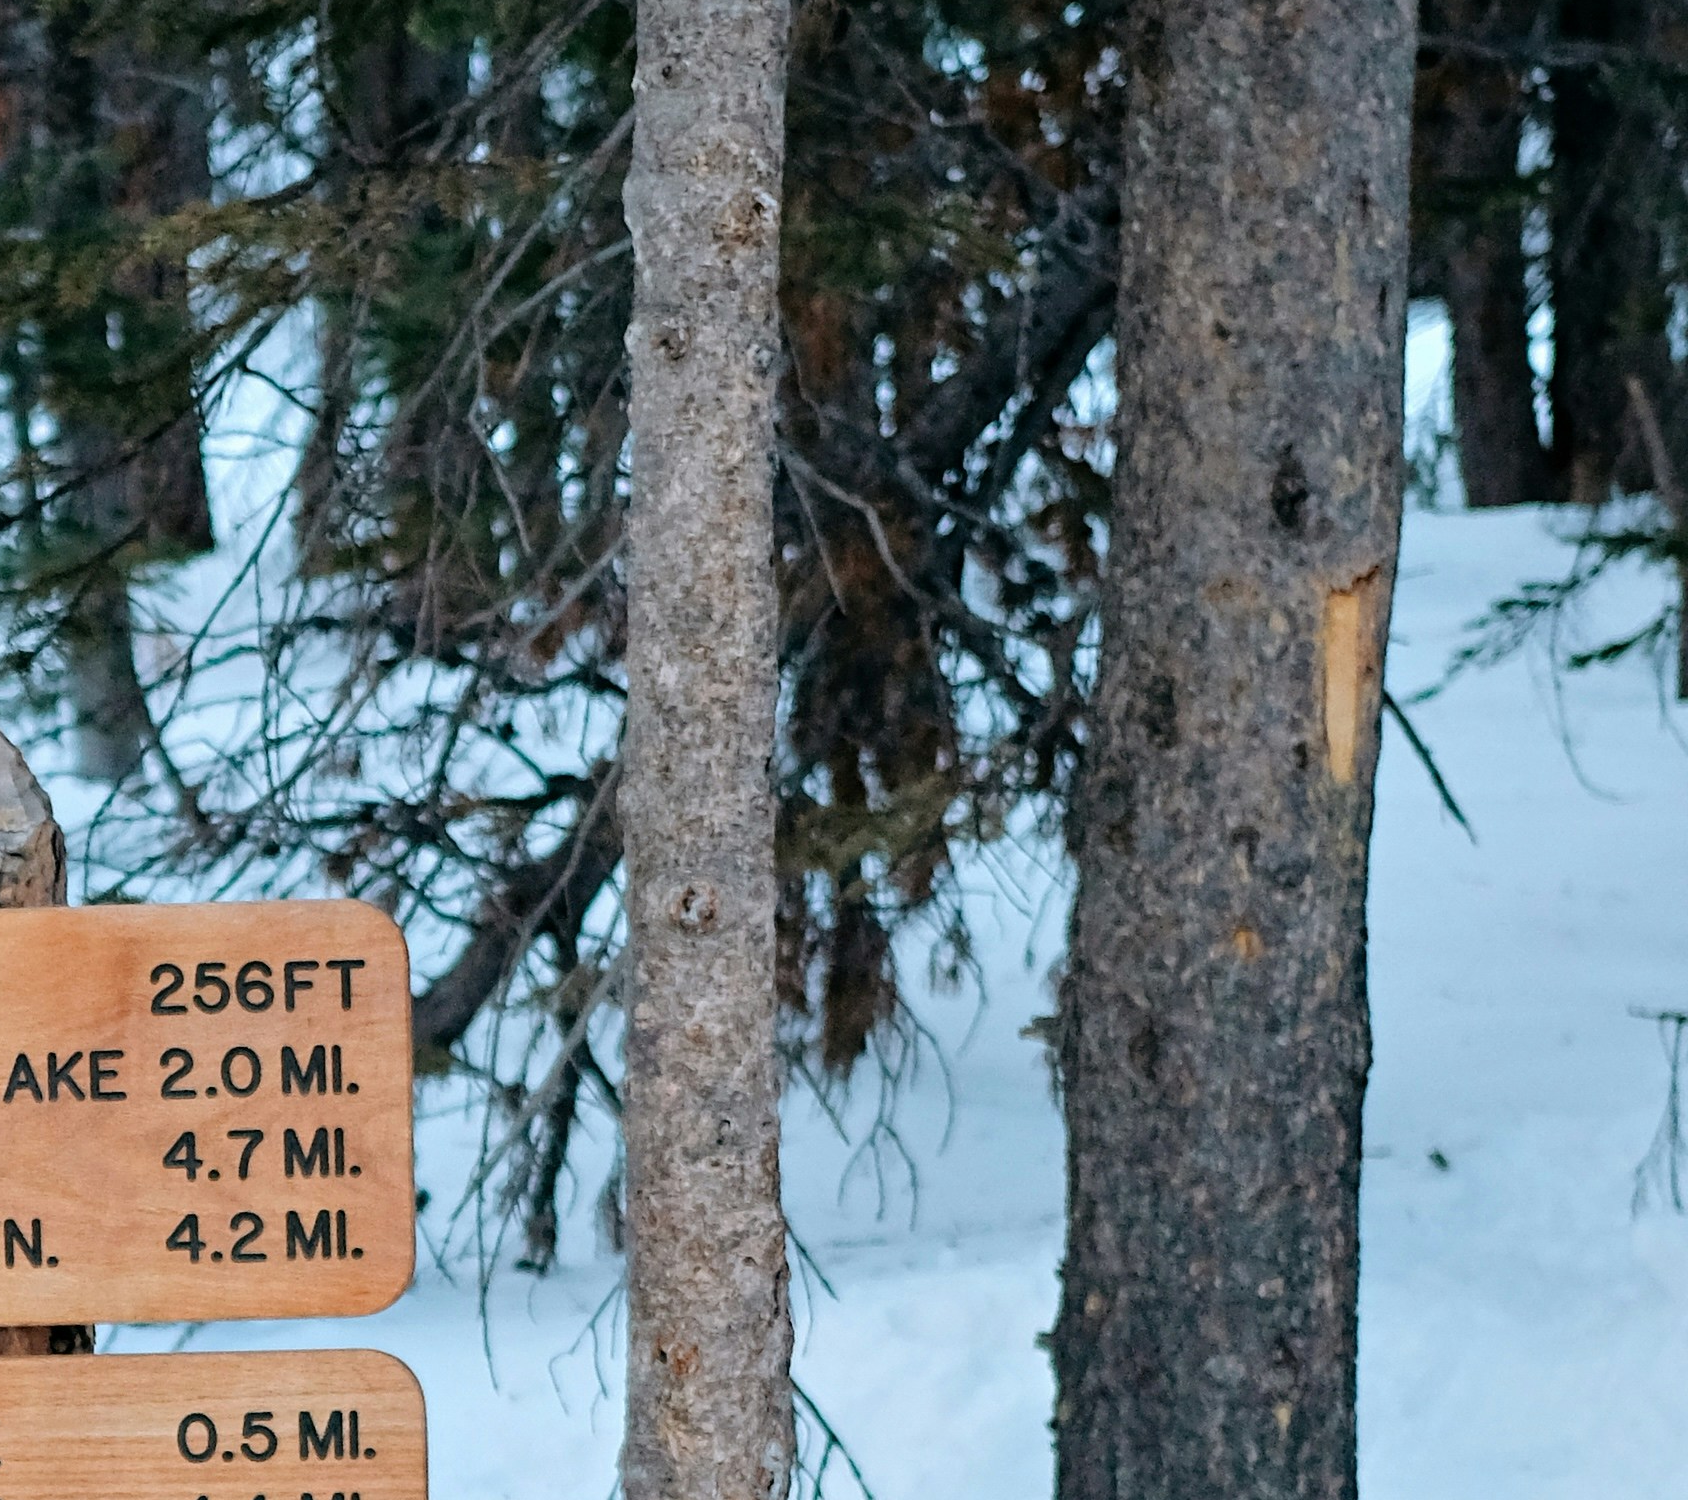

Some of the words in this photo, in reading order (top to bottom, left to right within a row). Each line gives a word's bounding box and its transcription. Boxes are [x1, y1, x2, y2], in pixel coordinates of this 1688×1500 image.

[150, 959, 366, 1016] 256FT
[159, 1046, 262, 1100] 2.0
[280, 1044, 360, 1095] MI.
[162, 1129, 264, 1182] 4.7
[283, 1126, 362, 1178] MI.
[165, 1211, 268, 1263] 4.2
[285, 1209, 364, 1260] MI.
[177, 1411, 278, 1463] 0.5
[298, 1410, 377, 1461] MI.
